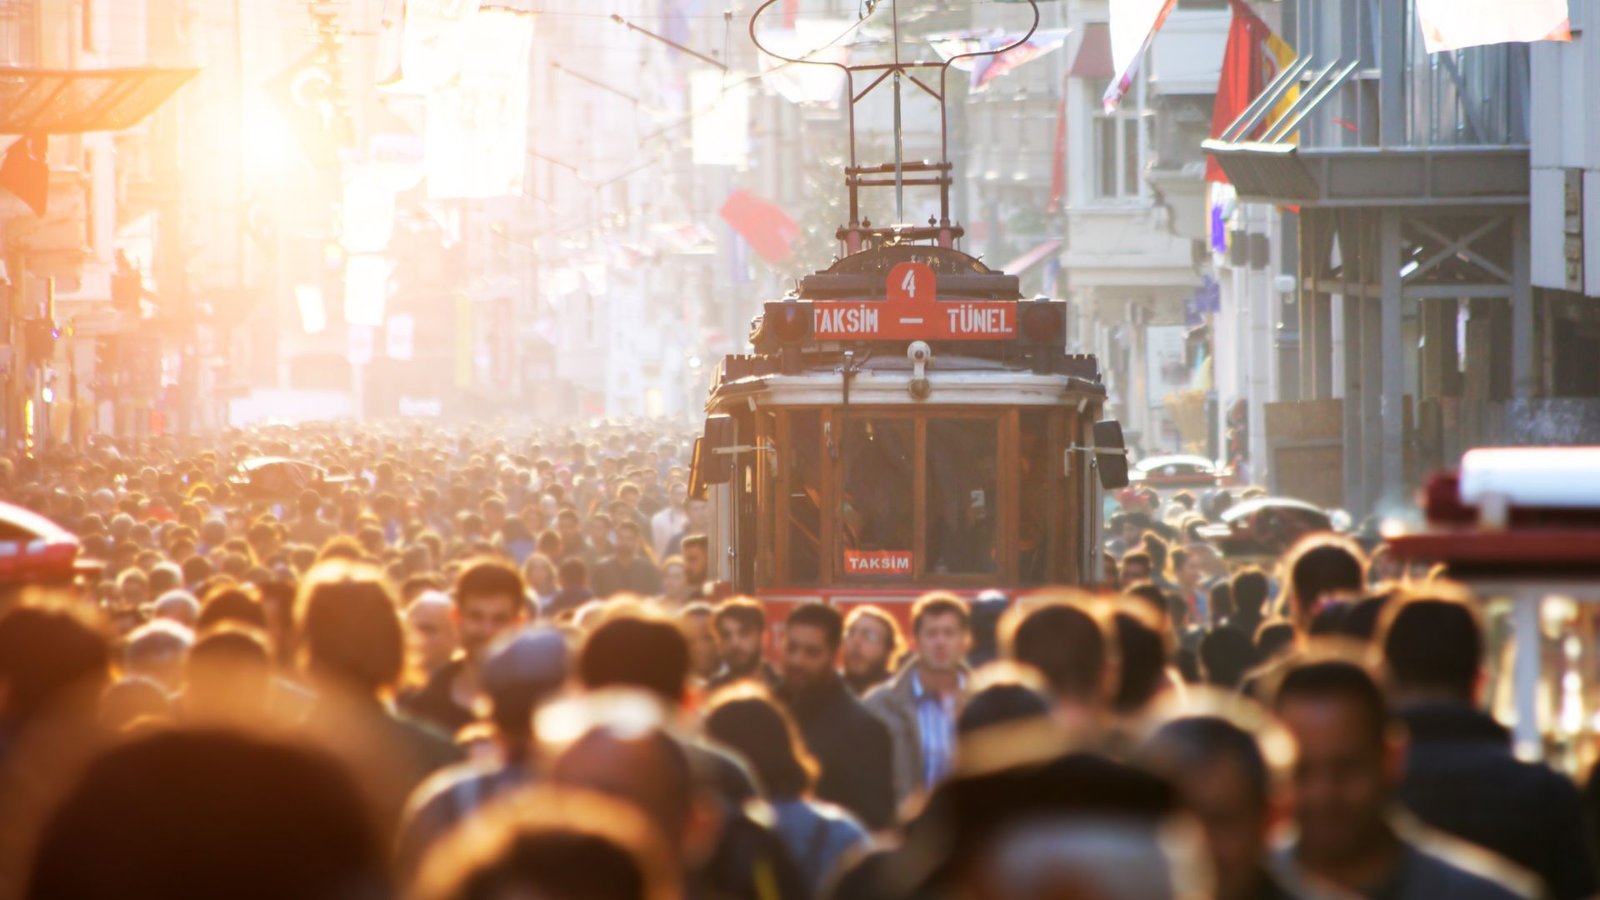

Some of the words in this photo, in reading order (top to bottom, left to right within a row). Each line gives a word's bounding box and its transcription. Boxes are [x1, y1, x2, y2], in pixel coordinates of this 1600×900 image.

[901, 269, 916, 298] 4
[946, 304, 1013, 333] TÜNEL
[849, 555, 909, 569] TAKSİM
